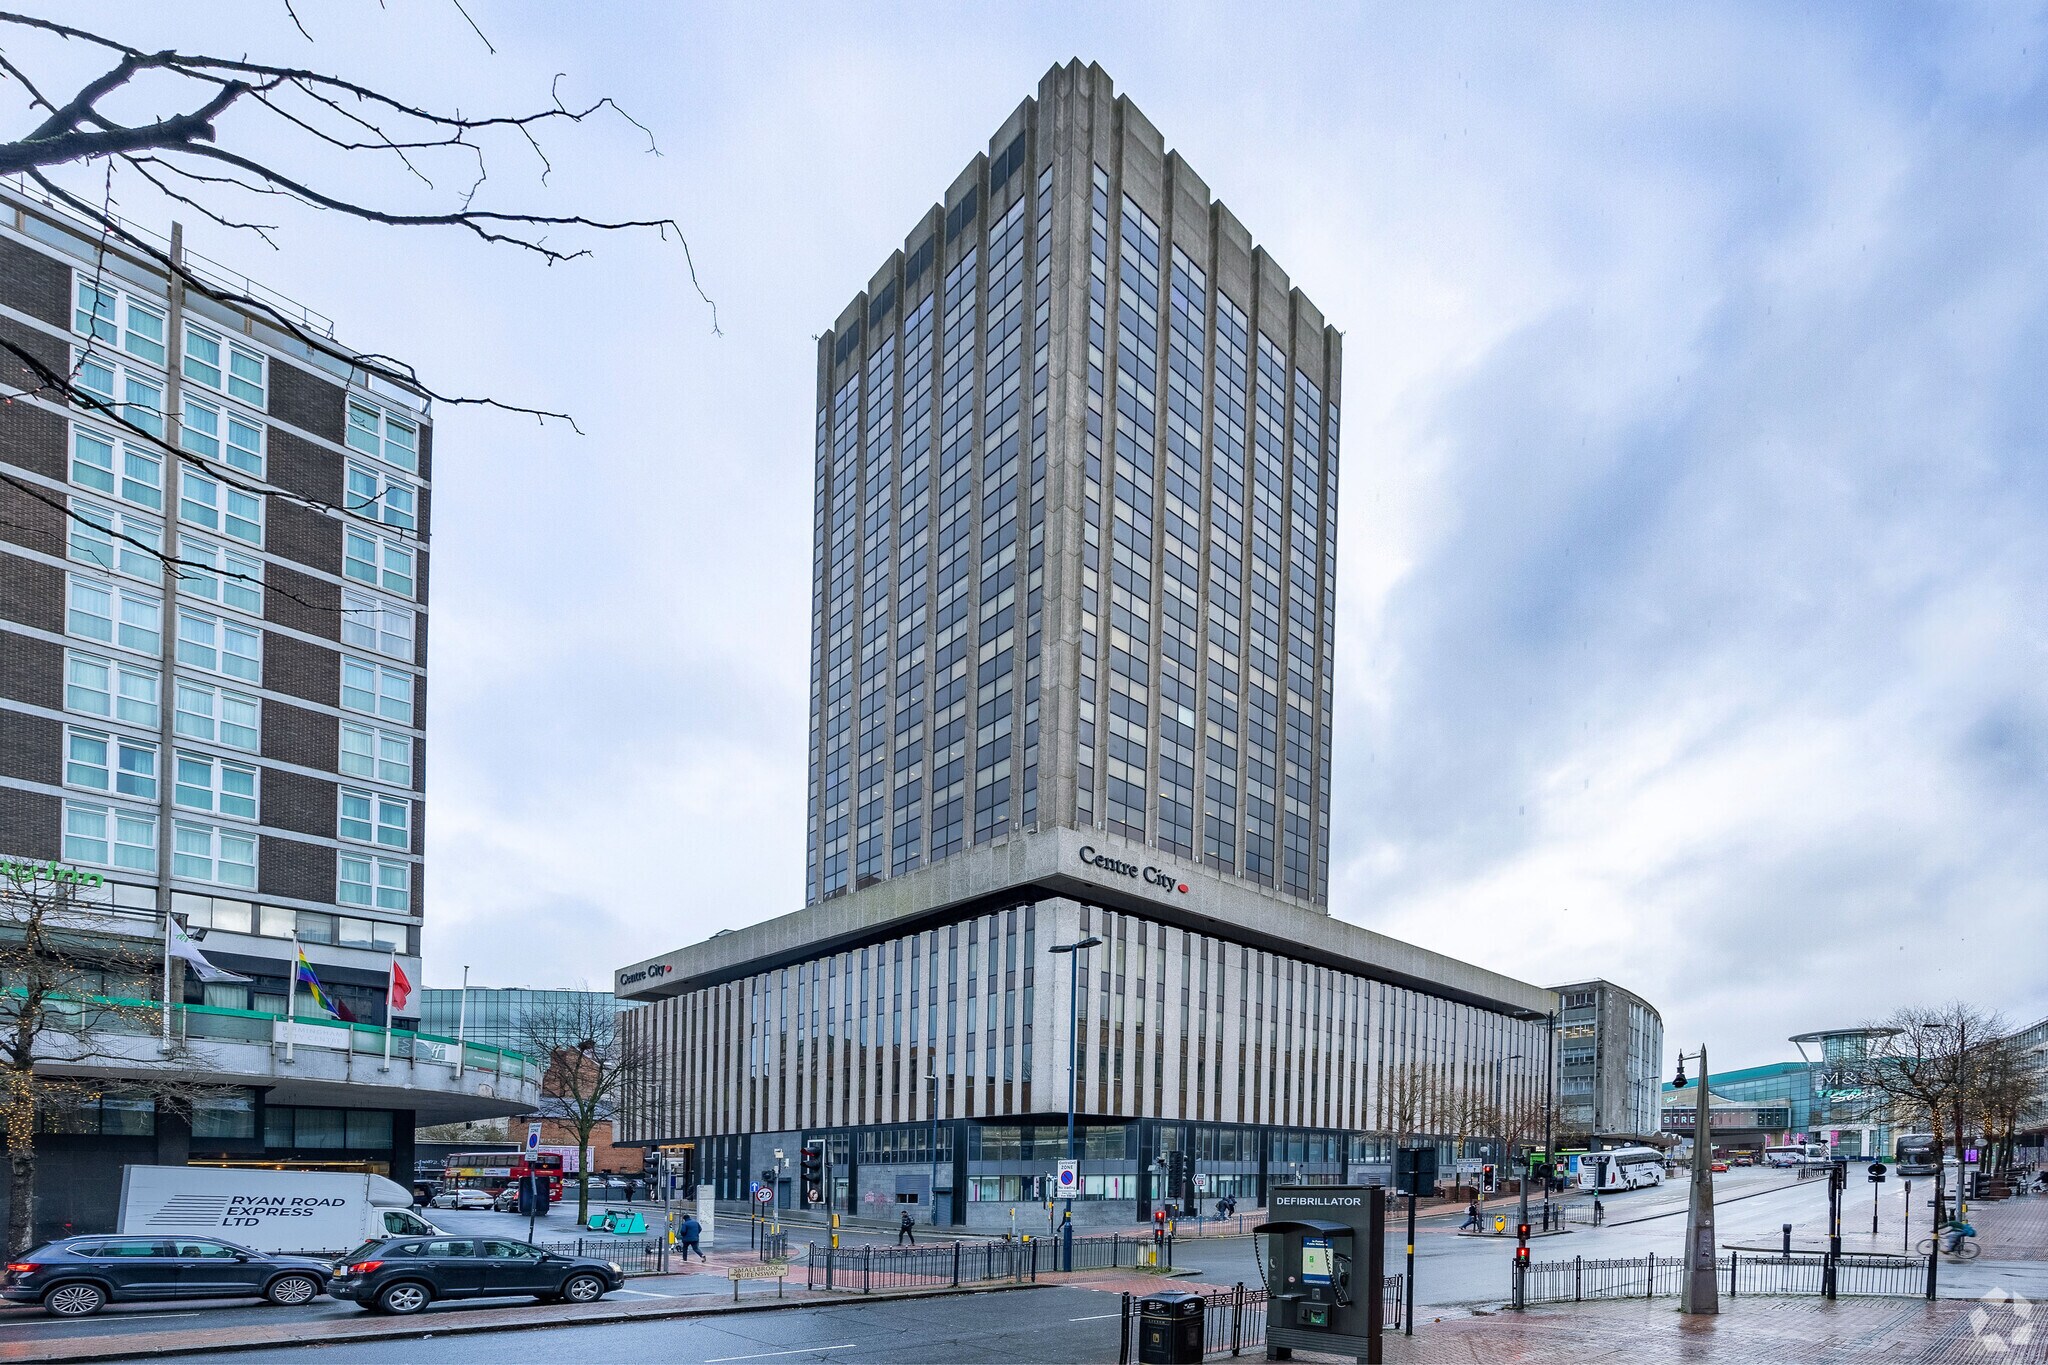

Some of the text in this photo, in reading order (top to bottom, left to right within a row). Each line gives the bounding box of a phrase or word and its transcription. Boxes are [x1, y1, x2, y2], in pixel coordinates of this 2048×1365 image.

[45, 860, 104, 888] Inn
[1080, 846, 1177, 892] Centre City
[620, 963, 666, 985] Centre City
[282, 1025, 343, 1037] BRMINGHAM
[1663, 1116, 1713, 1124] STRET
[231, 1196, 346, 1207] RYAN ROAD
[1276, 1197, 1361, 1206] DEFIBRILLATOR
[226, 1207, 314, 1217] EXPRESS
[222, 1217, 260, 1227] LTD
[733, 1265, 780, 1274] SMALLBROOK
[735, 1270, 778, 1279] QUEENSWAY
